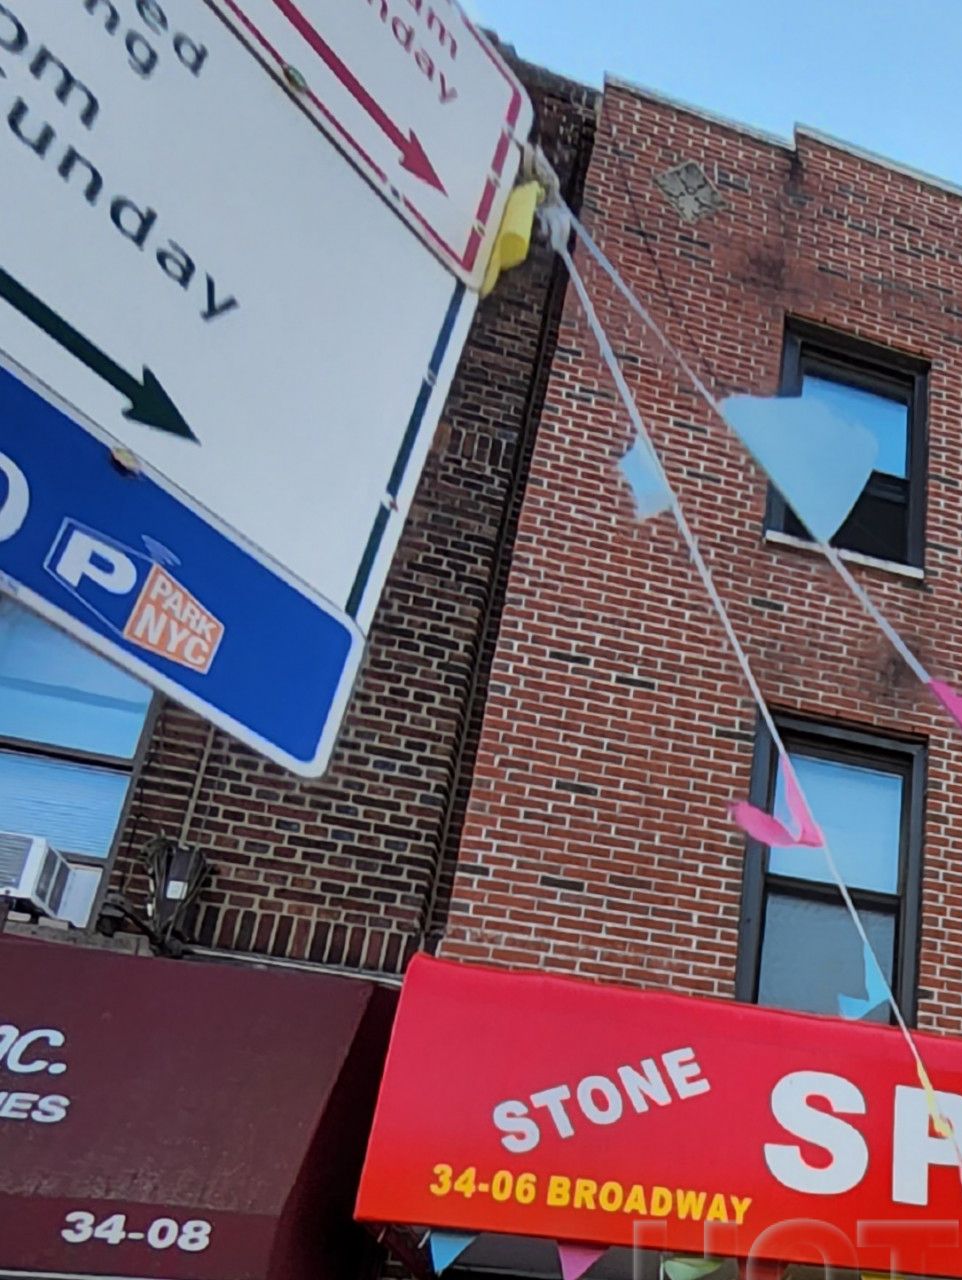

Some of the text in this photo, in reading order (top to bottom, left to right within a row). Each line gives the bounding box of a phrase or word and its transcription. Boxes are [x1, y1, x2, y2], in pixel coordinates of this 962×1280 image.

[405, 0, 457, 60] m
[0, 65, 239, 322] unday
[134, 602, 210, 665] NYC
[150, 573, 217, 642] PARK
[492, 1047, 710, 1154] STONE
[430, 1163, 752, 1225] 34-06 BROADWAY
[61, 1210, 213, 1252] 34-08
